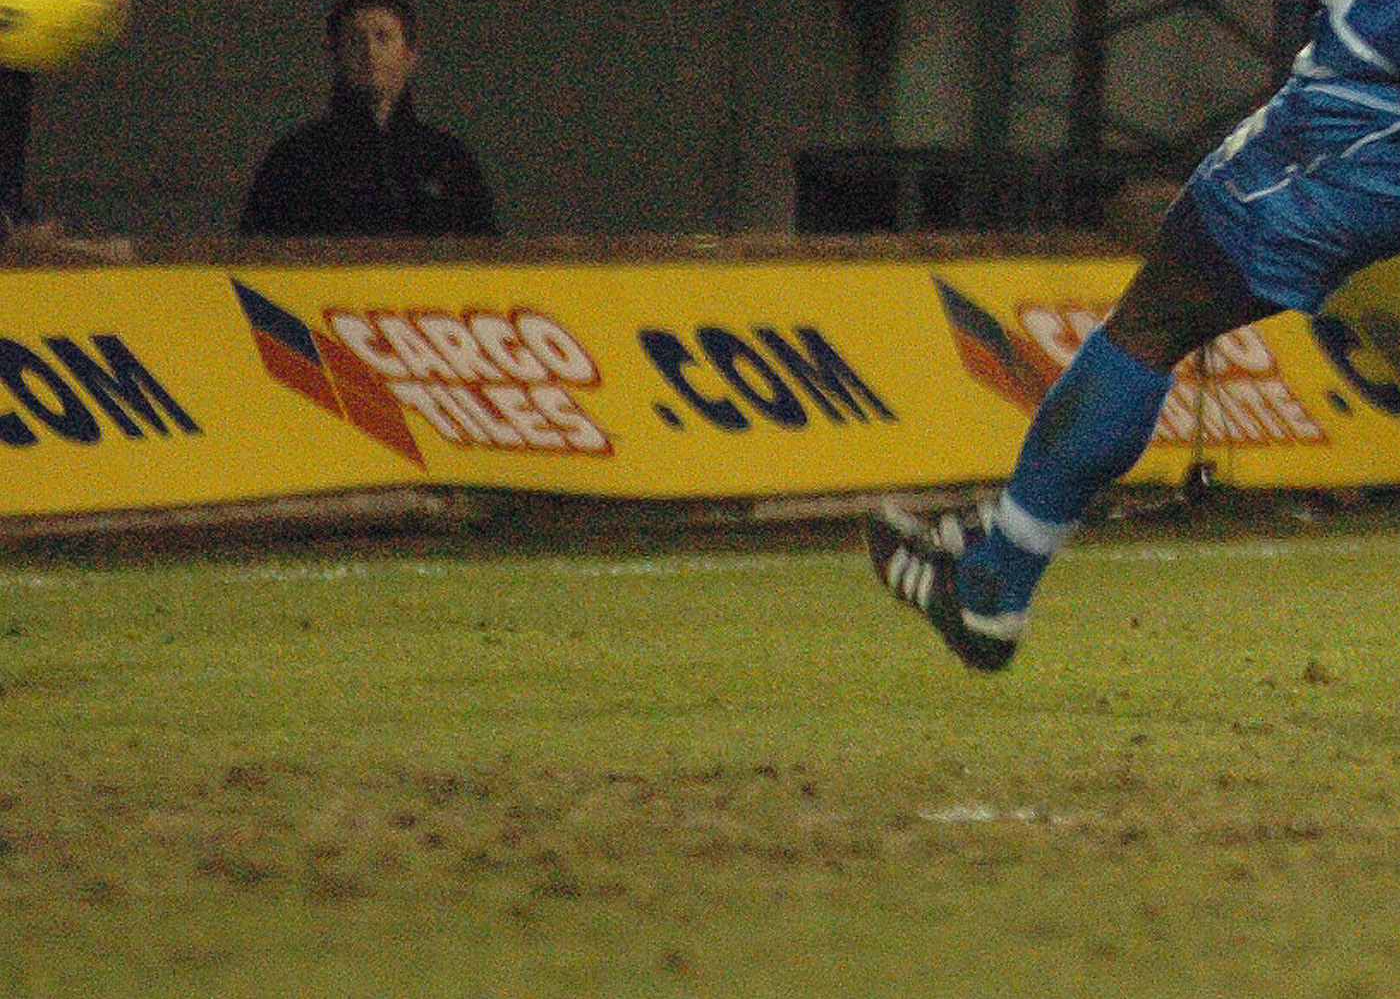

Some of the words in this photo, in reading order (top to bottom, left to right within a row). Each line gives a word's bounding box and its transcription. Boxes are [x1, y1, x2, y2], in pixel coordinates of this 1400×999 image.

[325, 307, 602, 389] CARGO
[638, 326, 898, 429] .COM
[386, 381, 614, 454] TILES
